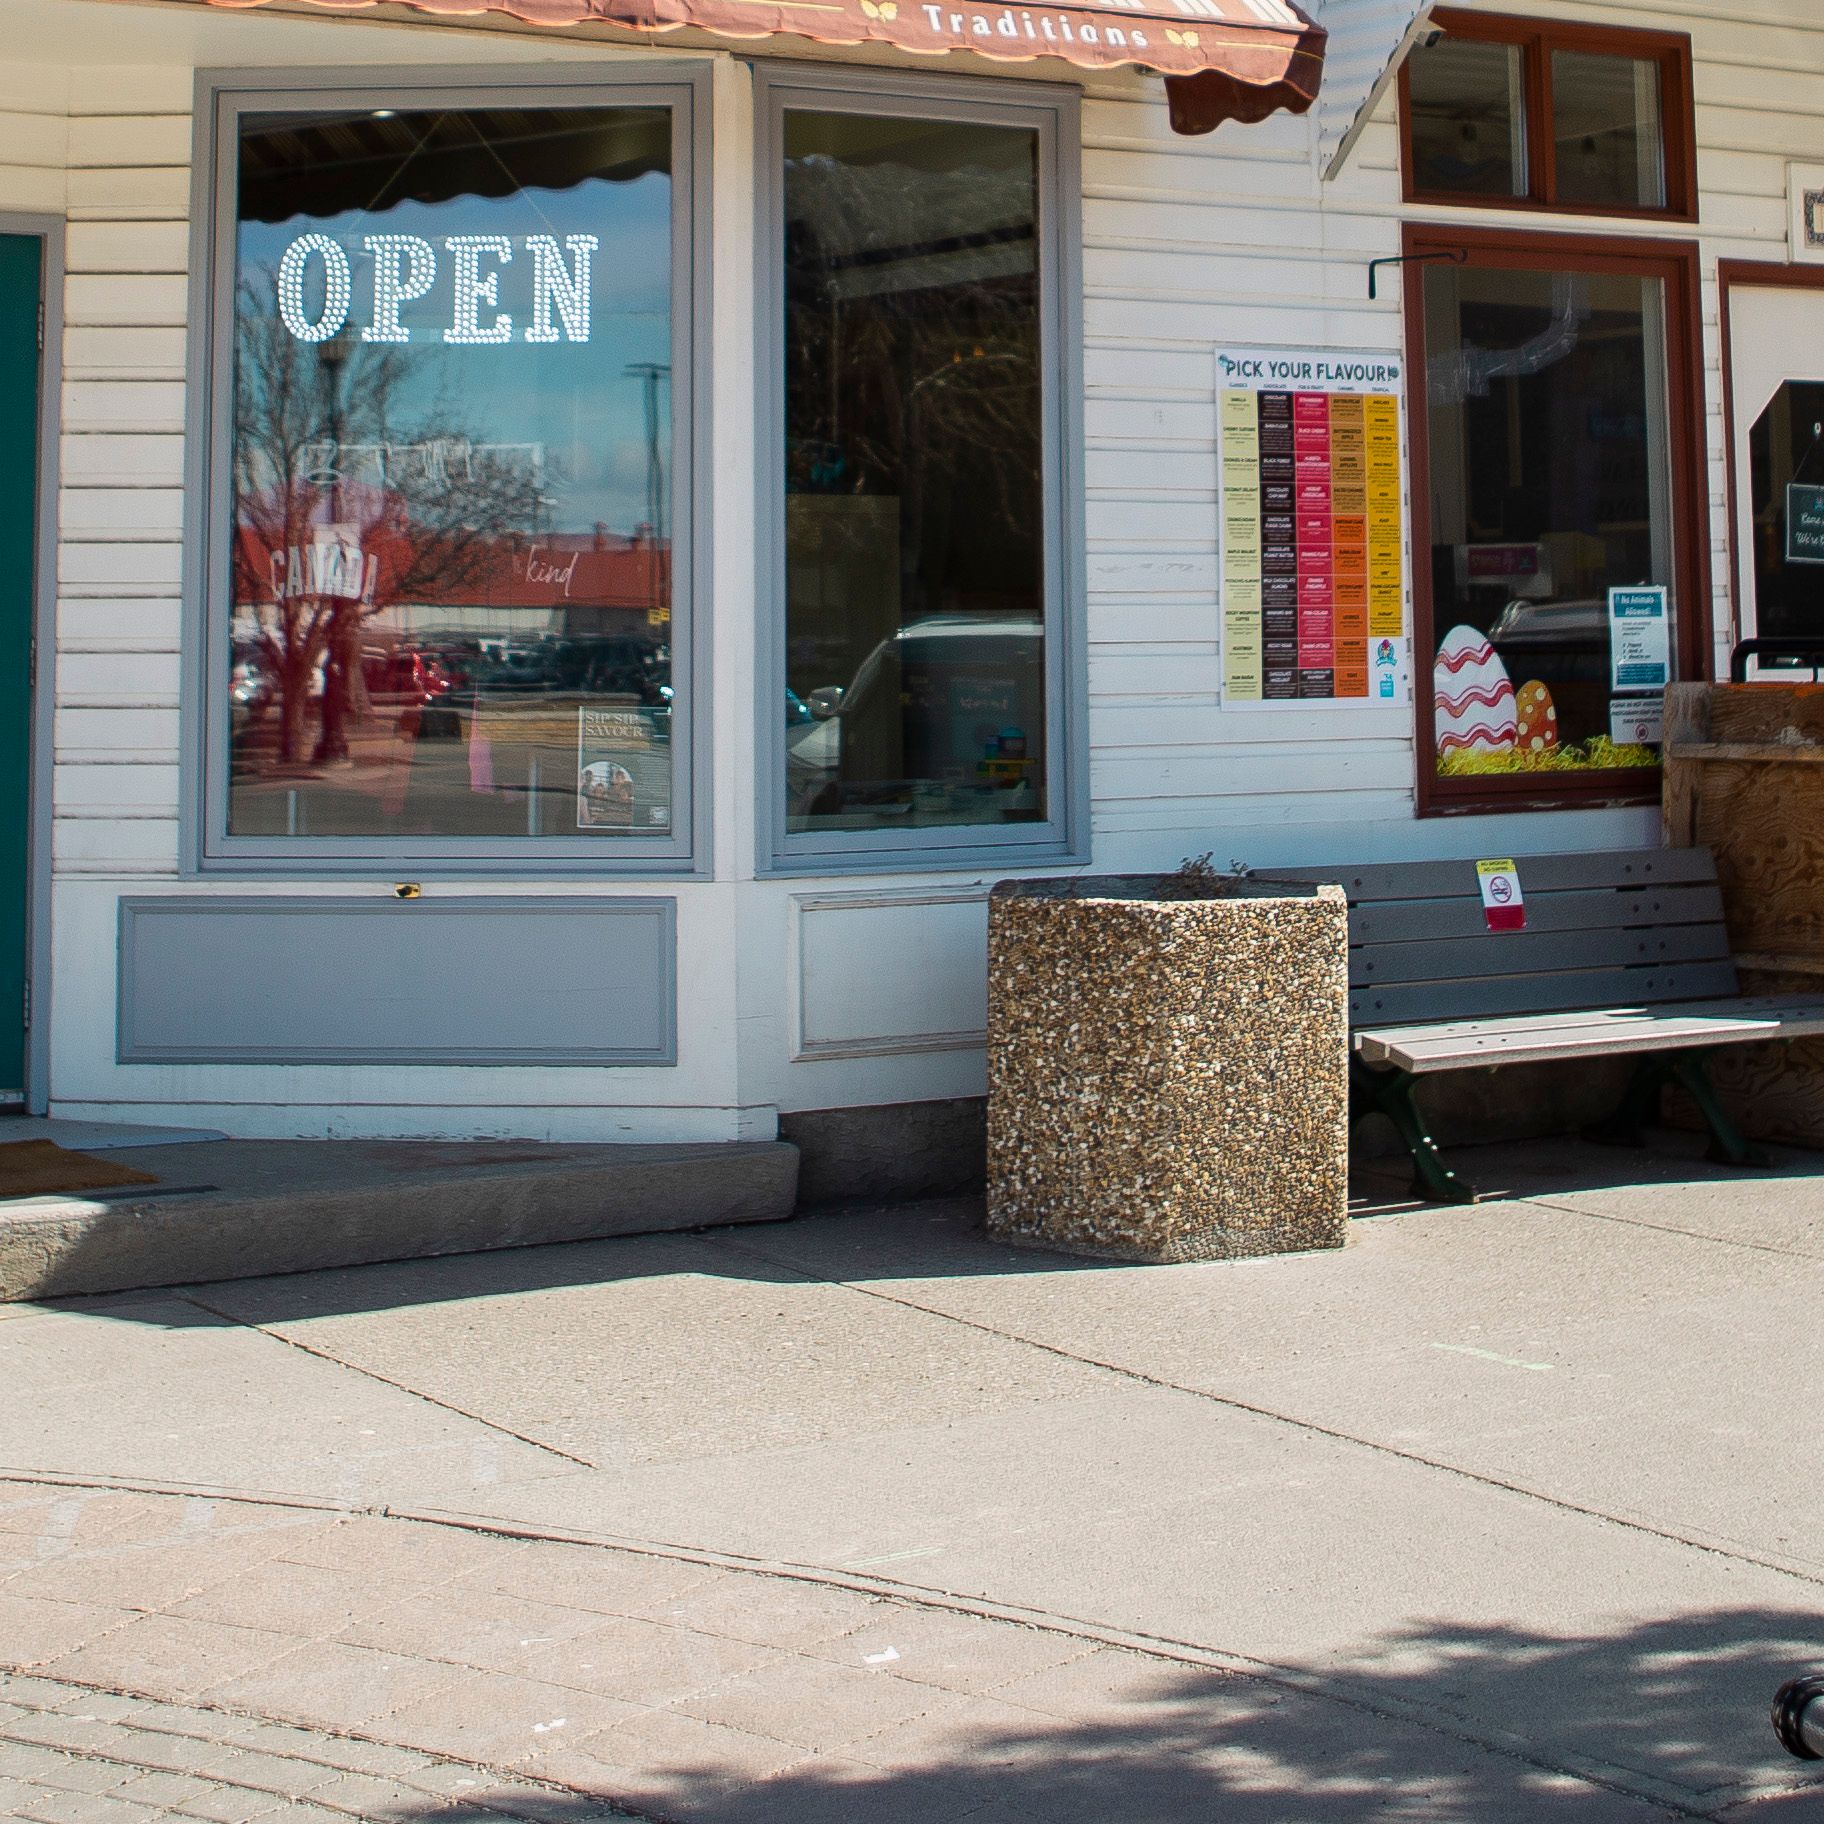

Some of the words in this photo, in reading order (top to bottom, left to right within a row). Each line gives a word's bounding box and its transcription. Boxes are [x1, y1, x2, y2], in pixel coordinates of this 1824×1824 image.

[921, 3, 1149, 49] Traditions
[277, 232, 601, 345] OPEN
[1225, 359, 1264, 378] PICK
[1268, 360, 1312, 380] YOUR
[585, 712, 611, 724] SIP
[615, 713, 639, 725] SIP
[586, 725, 644, 737] SAVOUR
